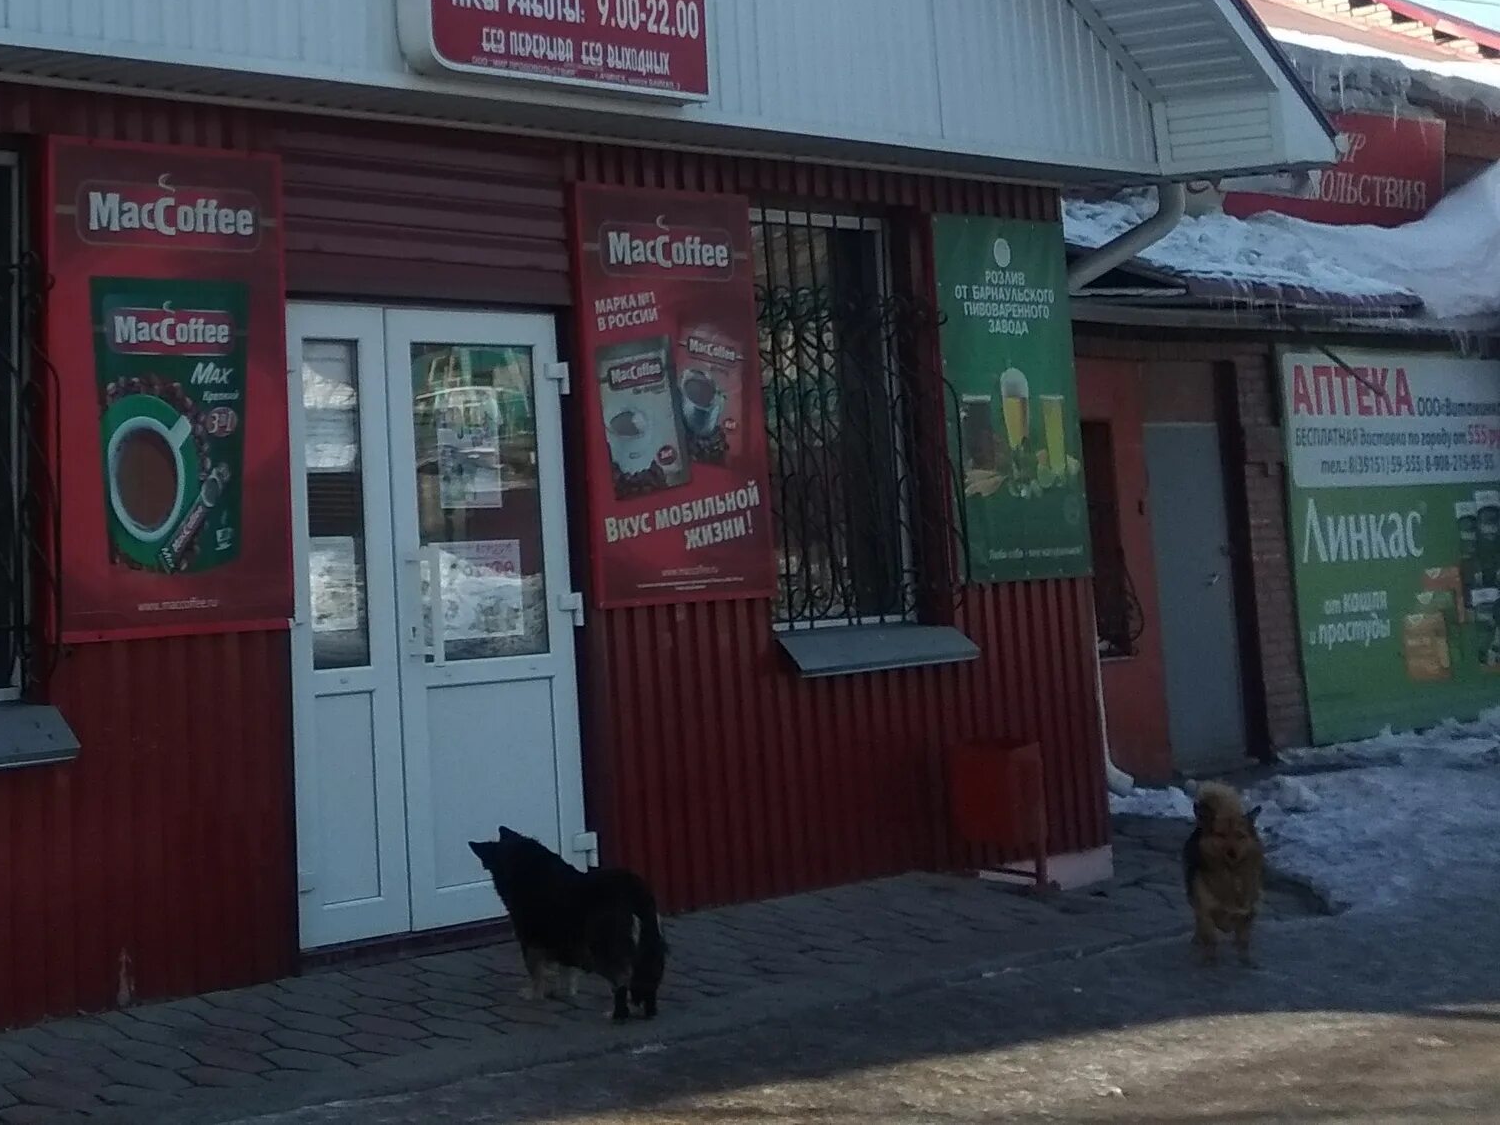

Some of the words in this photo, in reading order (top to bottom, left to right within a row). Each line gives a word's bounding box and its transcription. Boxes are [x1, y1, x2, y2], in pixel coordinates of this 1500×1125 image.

[481, 27, 505, 53] БЕЗ
[510, 31, 574, 63] ПЕРЕРЫВА
[581, 40, 603, 67] БЕЗ
[606, 43, 671, 76] ВЫХОДНЫХ
[88, 191, 254, 237] MacCoffee
[606, 231, 730, 269] MacCoffee
[985, 270, 1026, 286] РОЗЛИВ
[595, 293, 636, 314] МАРКА
[954, 284, 968, 299] ОТ
[971, 285, 1055, 303] БАРНАУЛЬСКОГО
[597, 316, 607, 332] В
[608, 307, 659, 330] РОССИИ
[963, 301, 1050, 319] ПИВОВАРЕННОГО
[113, 315, 231, 345] MacCoffee
[988, 319, 1029, 336] ЗАВОДА
[609, 361, 662, 384] MacCoffee
[1293, 364, 1415, 416] АПТЕКА
[1295, 427, 1360, 447] БЕСПЛАТНАЯ
[1361, 428, 1407, 446] доставка
[1420, 428, 1452, 450] городу
[1303, 498, 1425, 563] Линкас
